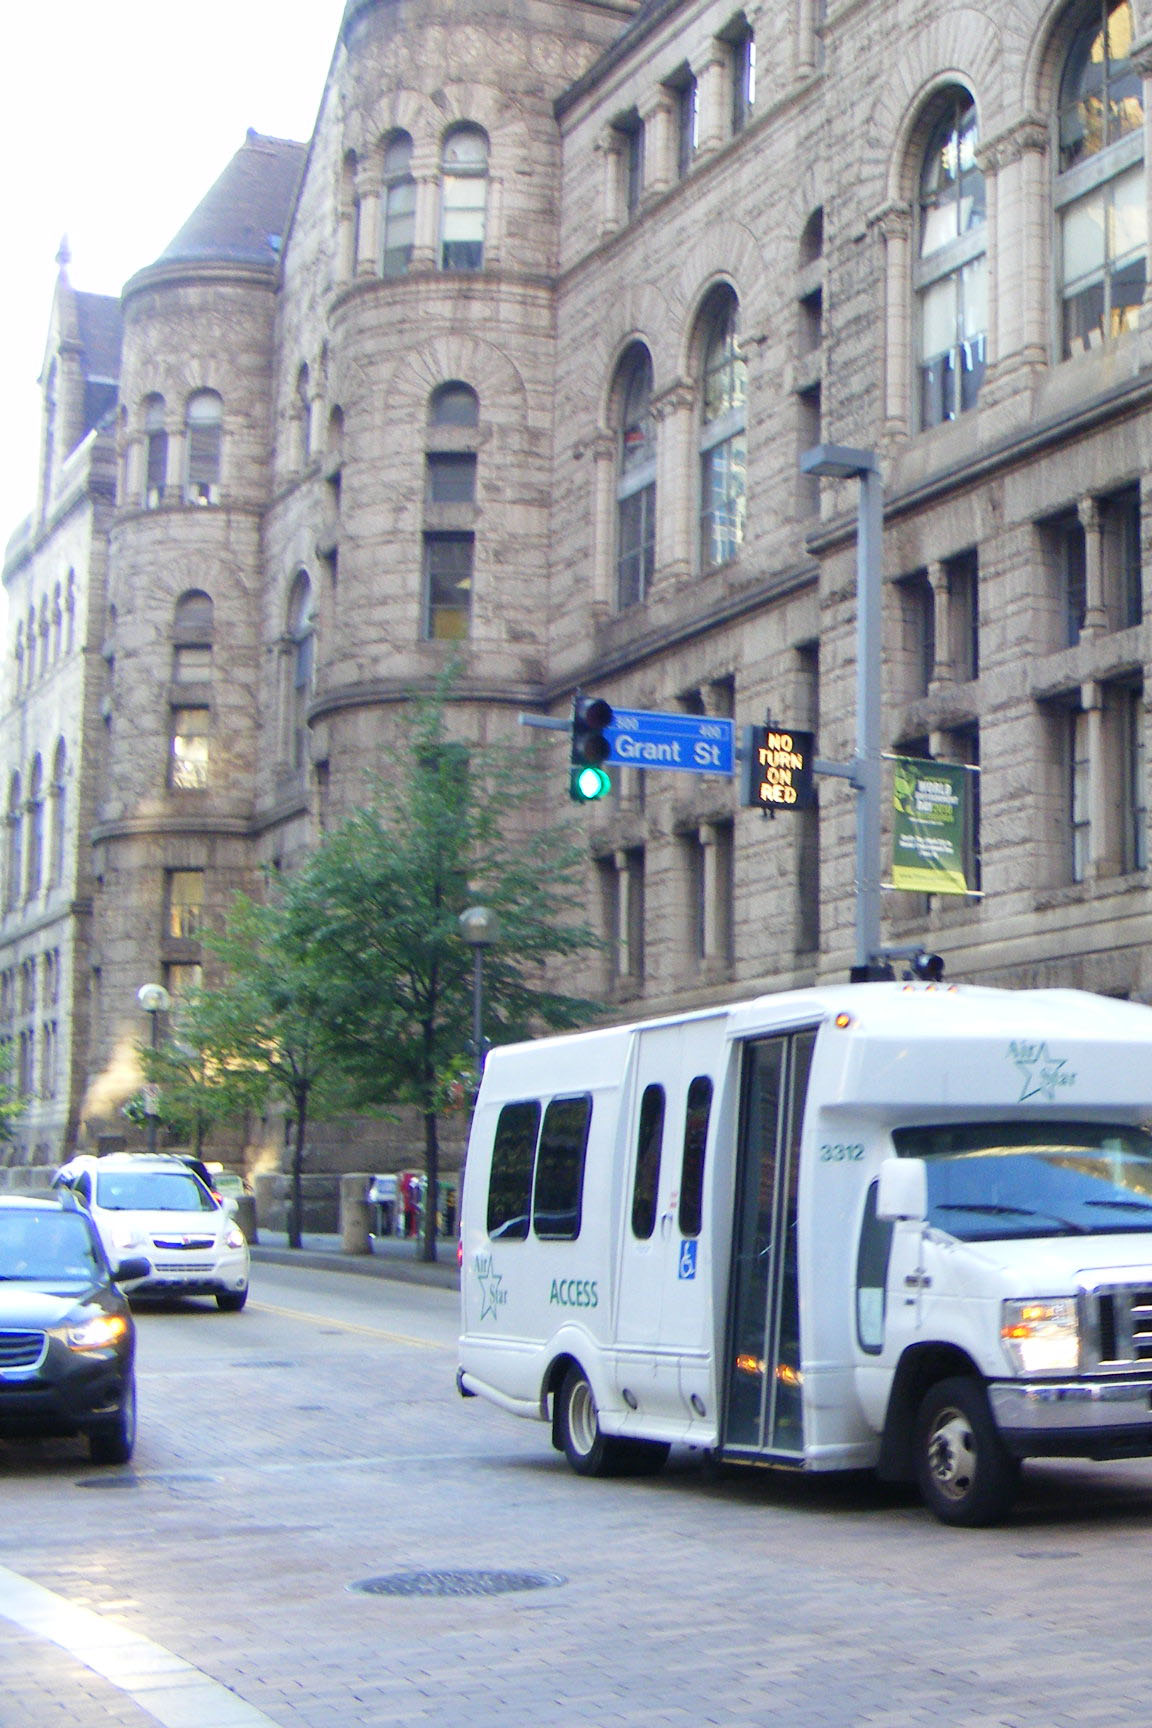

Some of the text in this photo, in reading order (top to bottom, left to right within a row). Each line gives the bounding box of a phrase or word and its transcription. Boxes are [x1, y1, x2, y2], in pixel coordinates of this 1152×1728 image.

[615, 734, 721, 766] Grant St
[767, 732, 793, 752] NO
[758, 748, 803, 770] TURN
[766, 767, 792, 786] ON
[760, 782, 798, 804] RED
[820, 1143, 866, 1162] 3312
[549, 1278, 599, 1308] ACCESS
